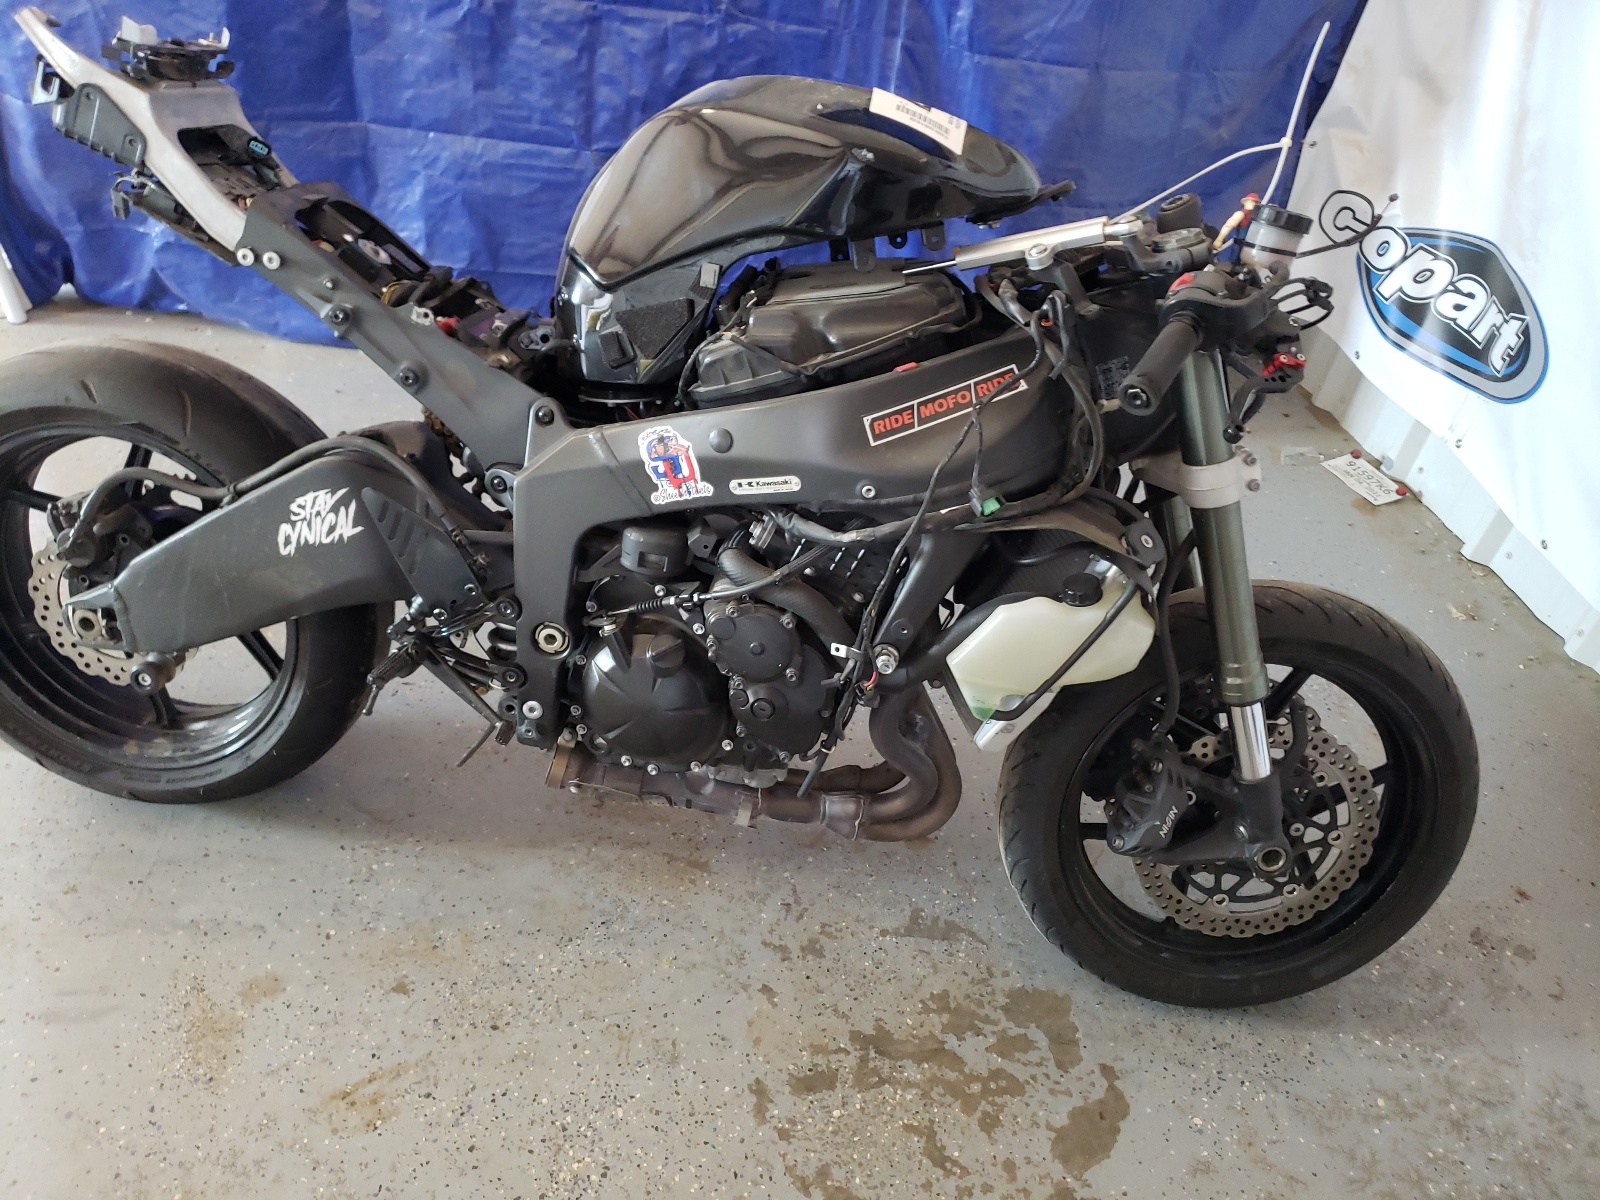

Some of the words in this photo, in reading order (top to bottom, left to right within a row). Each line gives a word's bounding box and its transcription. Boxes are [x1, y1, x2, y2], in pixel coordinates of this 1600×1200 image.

[1319, 190, 1529, 377] Copart
[873, 409, 914, 435] RIDE
[919, 390, 971, 418] MOFO
[289, 487, 350, 522] STAY
[755, 479, 792, 488] Kawasaki
[277, 498, 366, 557] CYNICAL
